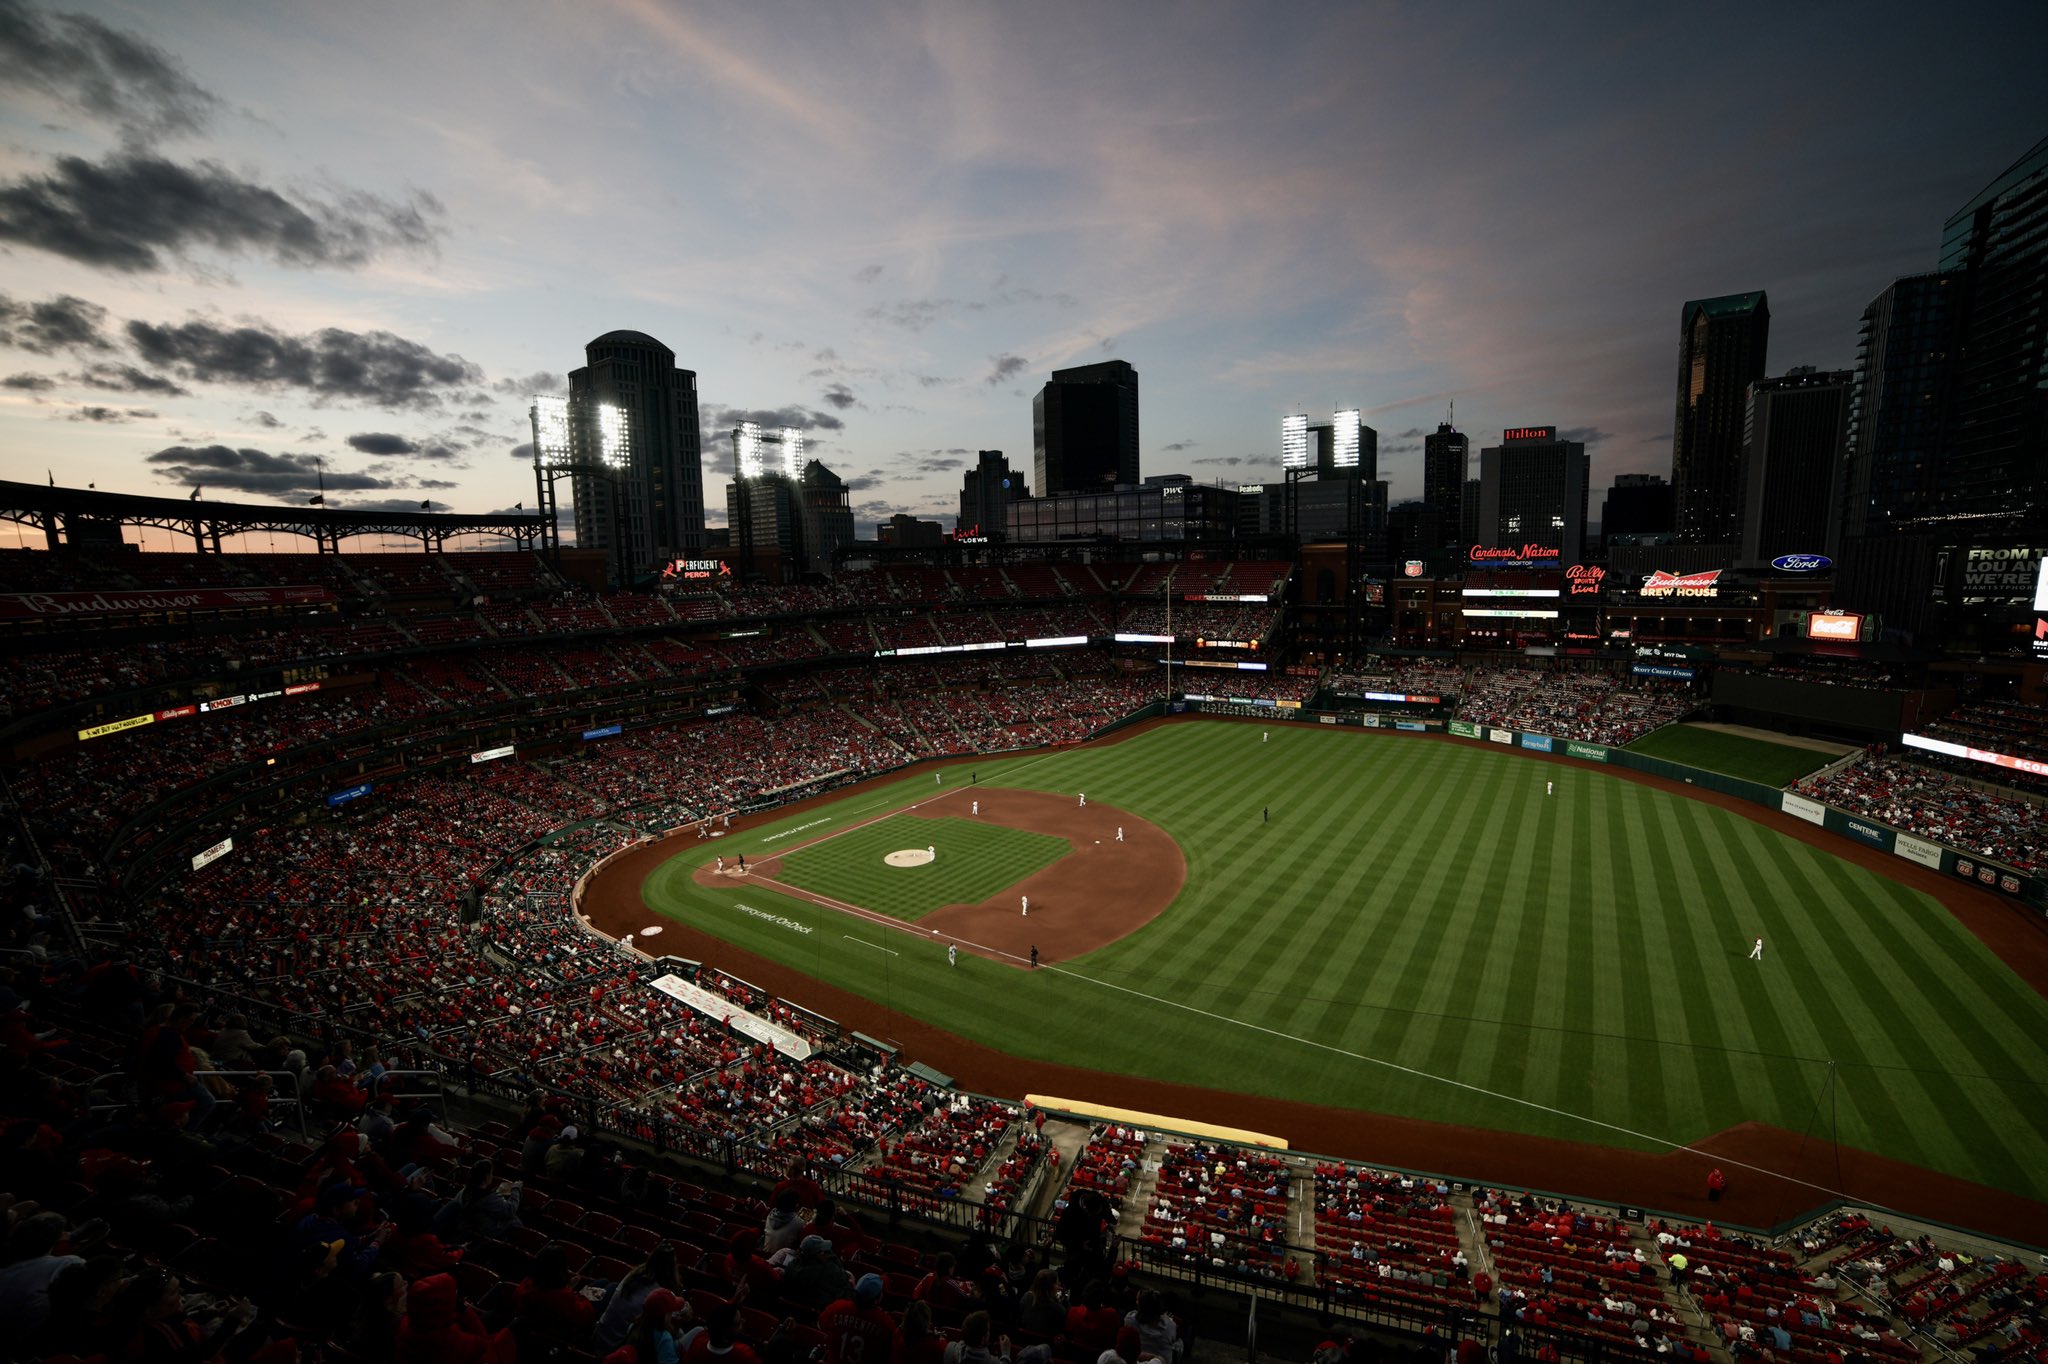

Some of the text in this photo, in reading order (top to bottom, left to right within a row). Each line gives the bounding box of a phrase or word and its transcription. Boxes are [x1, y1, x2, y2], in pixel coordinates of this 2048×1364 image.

[1505, 427, 1548, 440] Hilton
[1163, 486, 1183, 496] pwc
[1240, 485, 1264, 494] Peabody
[952, 523, 979, 541] Live!
[1469, 543, 1560, 561] Cardinals Nation
[1967, 548, 2030, 560] FROM
[675, 559, 718, 572] PERFICIENT
[1783, 556, 1820, 568] Ford
[1966, 560, 2041, 572] LOU AN
[684, 571, 710, 579] PERCH
[1566, 564, 1606, 581] Bally
[1642, 575, 1718, 588] Budweiser
[1965, 573, 2033, 585] WE'RE
[1571, 585, 1599, 594] Live!
[1640, 588, 1718, 597] BREW HOUSE
[17, 592, 204, 615] Budweiser
[1632, 665, 1652, 673] SCOTT
[1673, 669, 1693, 677] UNION
[211, 698, 233, 709] KMOX
[1576, 745, 1606, 757] National
[1848, 821, 1881, 838] CENTENE
[1897, 839, 1940, 859] WELLS FARGO
[1959, 864, 1970, 874] 66
[1980, 873, 1993, 882] 66
[2003, 882, 2016, 891] 66
[840, 1331, 865, 1364] 13
